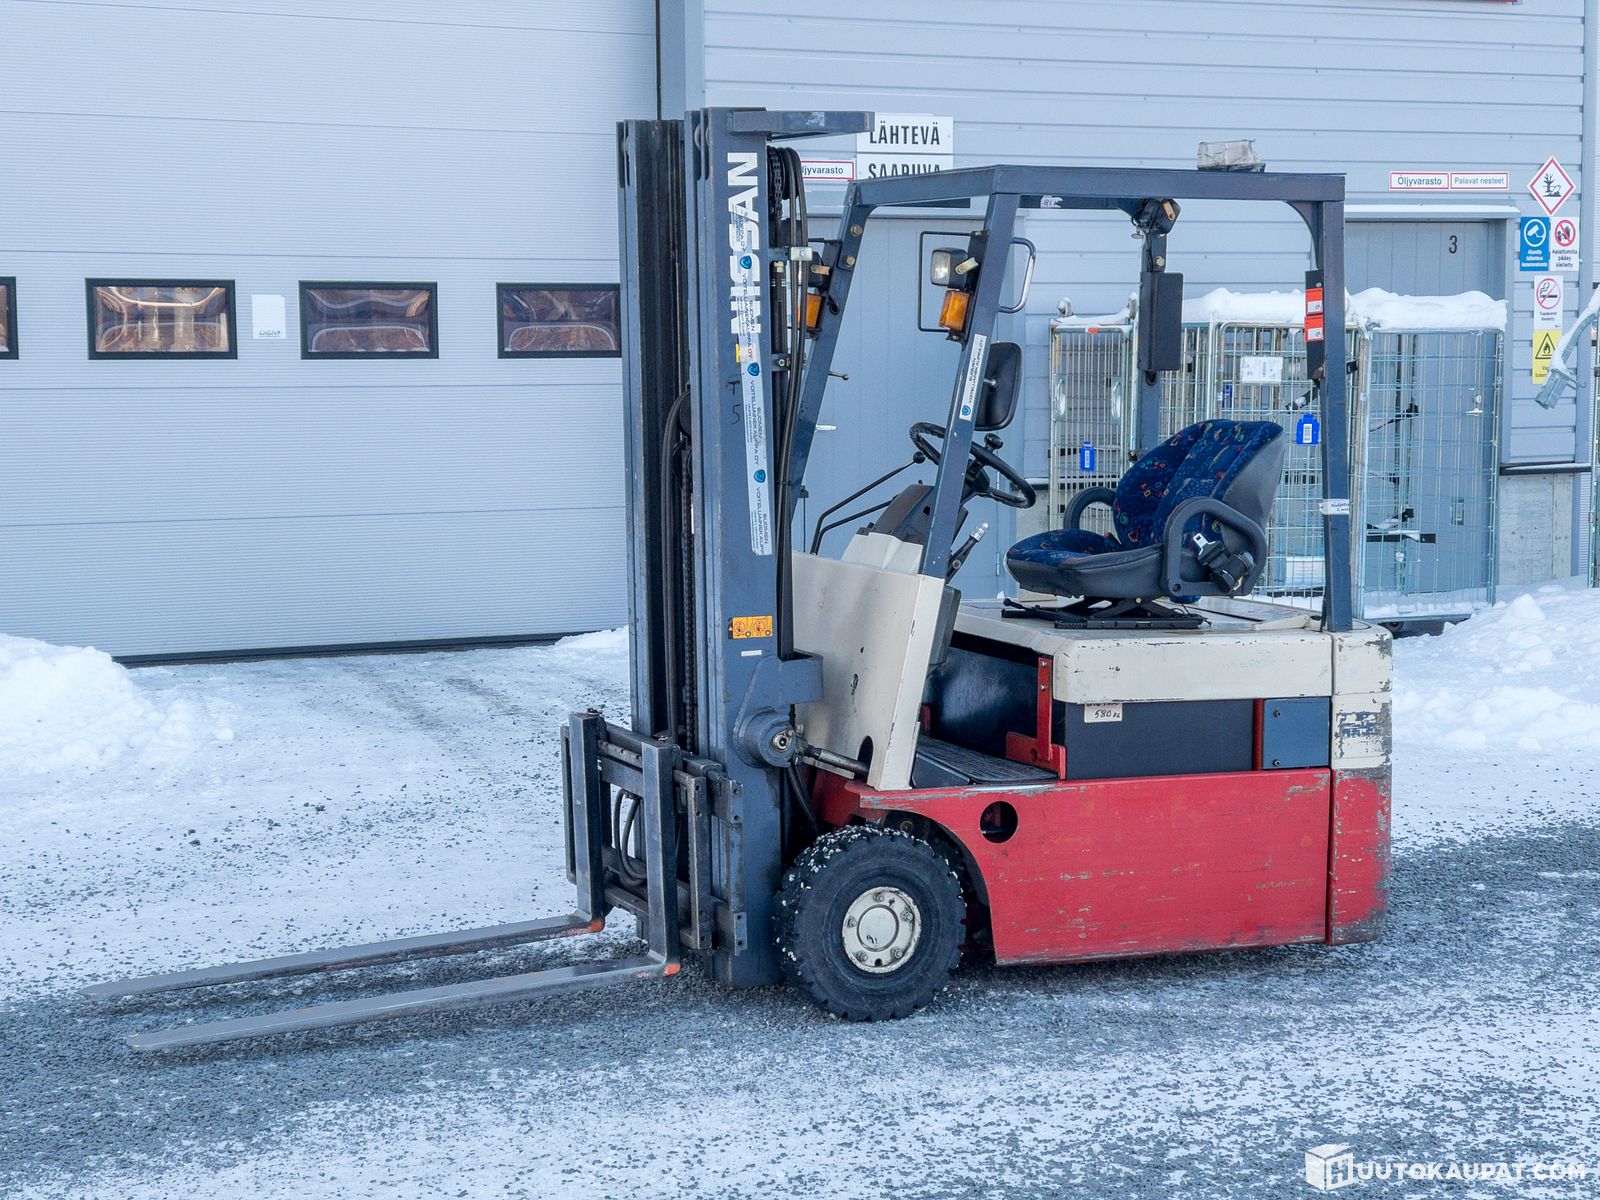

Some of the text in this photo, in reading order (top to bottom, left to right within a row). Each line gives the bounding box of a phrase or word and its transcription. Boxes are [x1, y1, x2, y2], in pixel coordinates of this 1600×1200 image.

[869, 120, 940, 145] LÄHTEVÄ
[802, 165, 844, 175] ljyvarasto
[1397, 175, 1442, 187] Öljyvarasto
[1454, 177, 1504, 185] Palavat nesteet
[727, 152, 761, 334] NISSAN
[1448, 235, 1458, 254] 3
[1094, 709, 1112, 719] 580
